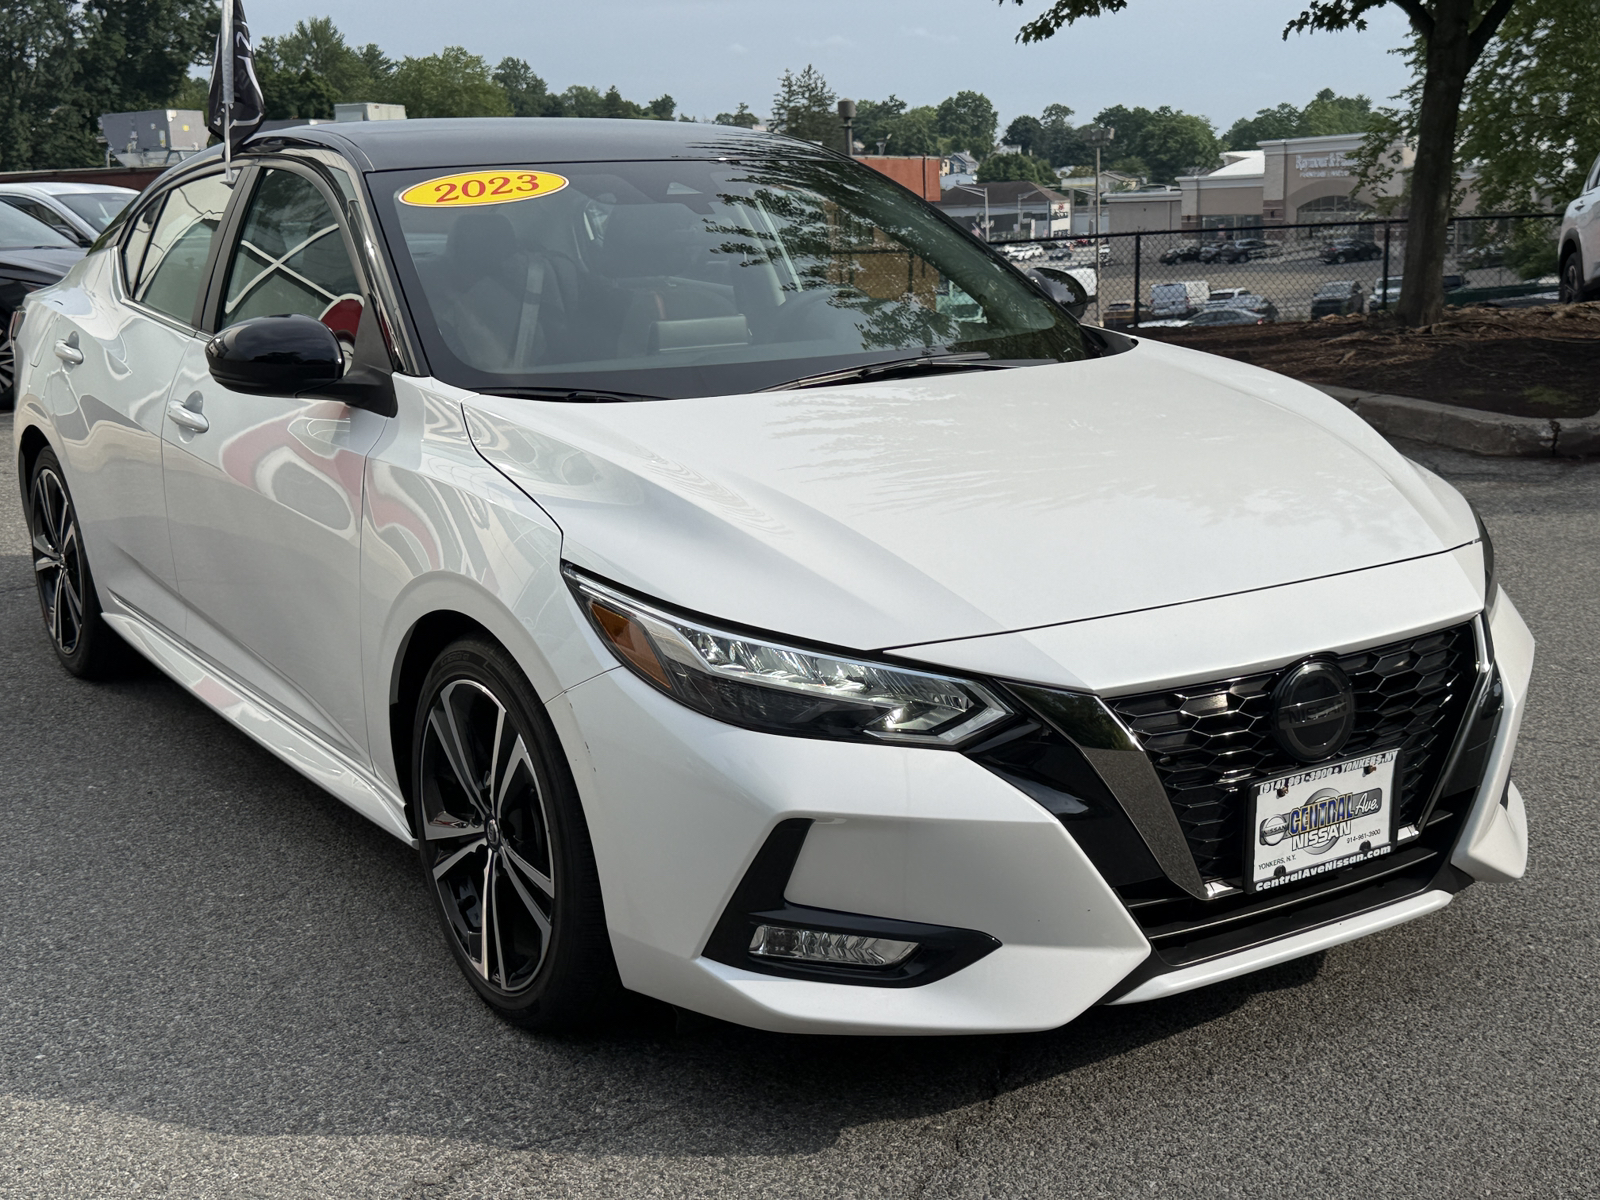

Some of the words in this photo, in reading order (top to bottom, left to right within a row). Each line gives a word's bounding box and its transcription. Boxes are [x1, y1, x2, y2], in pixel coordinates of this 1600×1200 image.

[434, 174, 540, 202] 2023
[1289, 699, 1347, 723] NISSAN
[1290, 792, 1354, 837] CENTRAL
[1355, 793, 1379, 816] Ave.
[1292, 820, 1352, 852] NISSAN
[1346, 828, 1381, 843] 914-961-3900
[1255, 845, 1391, 892] CentralAveNissan.com
